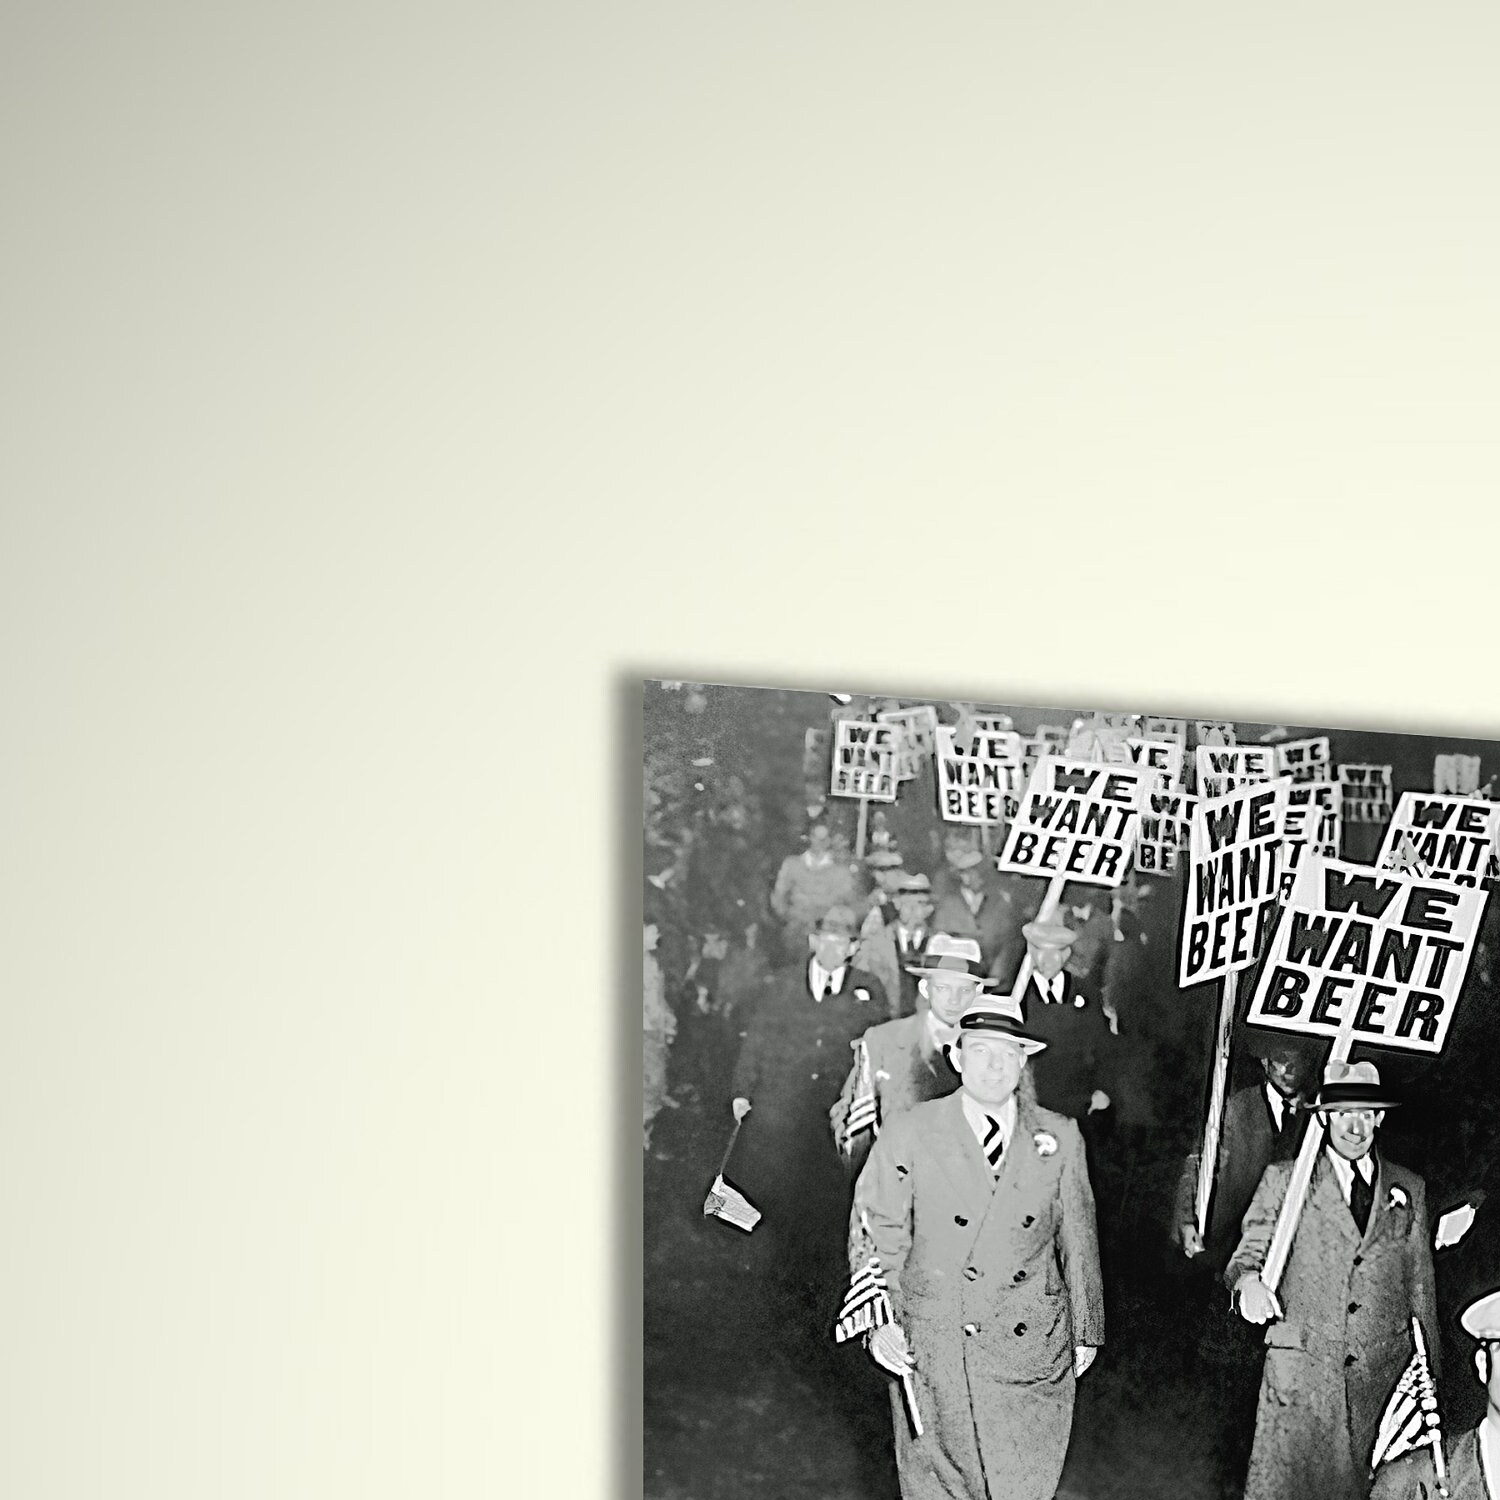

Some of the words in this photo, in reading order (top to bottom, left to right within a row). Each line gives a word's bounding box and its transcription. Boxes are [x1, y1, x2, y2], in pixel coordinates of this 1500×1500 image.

[943, 758, 1016, 791] WANT
[1054, 764, 1138, 803] WE
[1209, 752, 1265, 774] WE
[1029, 794, 1138, 841] WANT
[1204, 790, 1276, 852] WE
[1411, 800, 1491, 834] WE
[1009, 831, 1123, 878] BEER
[1390, 828, 1491, 872] WANT
[1195, 838, 1283, 917] WANT
[1324, 867, 1460, 934] WE
[1286, 910, 1465, 989] WANT
[1259, 965, 1445, 1042] BEER
